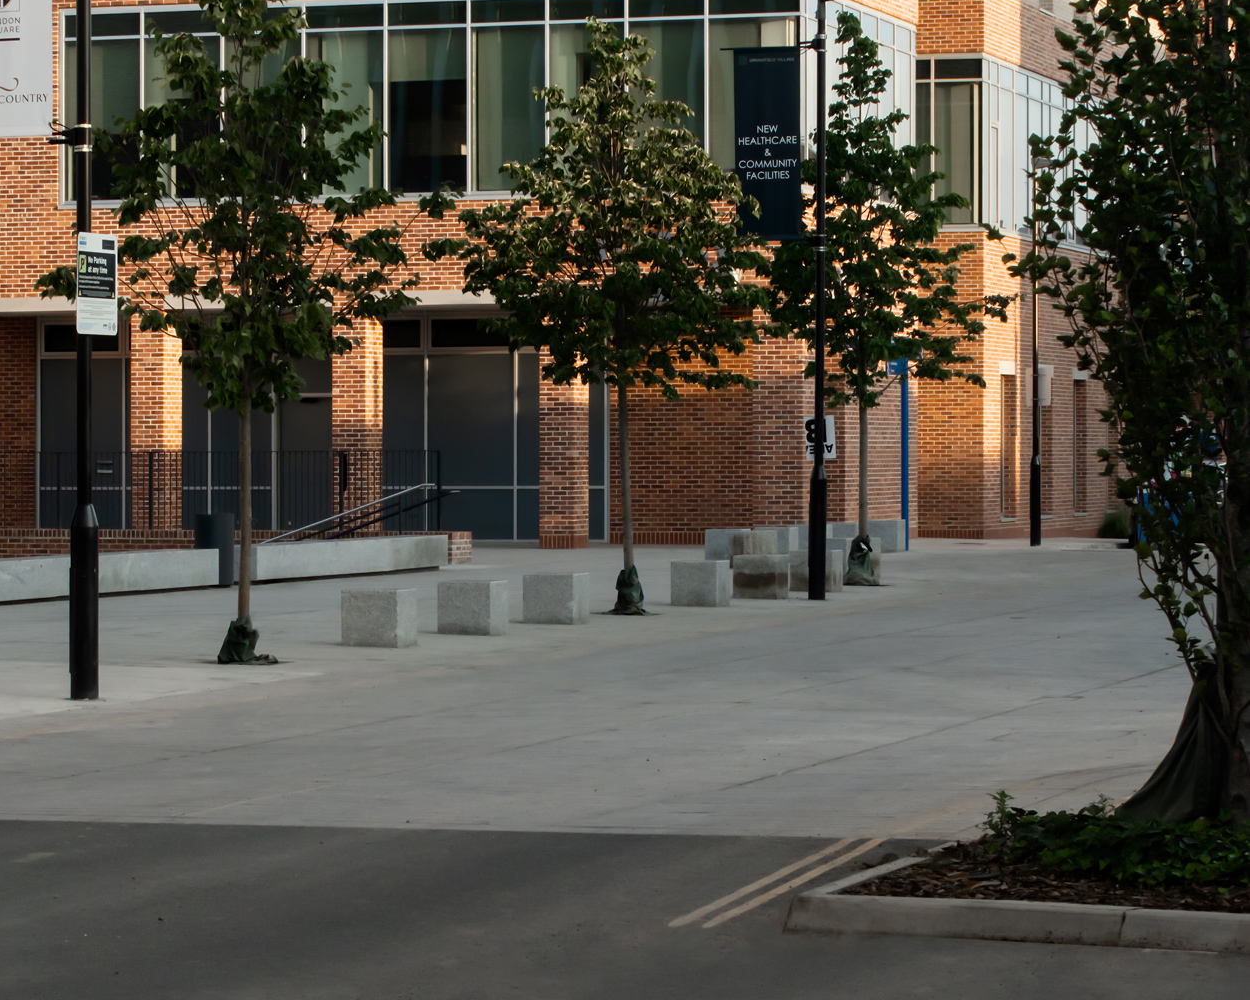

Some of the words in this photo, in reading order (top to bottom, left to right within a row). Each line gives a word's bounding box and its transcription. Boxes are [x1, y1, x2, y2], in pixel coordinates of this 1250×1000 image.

[756, 124, 779, 134] NEW
[738, 135, 798, 146] HEALTHCARE
[764, 148, 772, 157] &
[738, 158, 798, 169] COMMUNITY
[746, 170, 791, 180] FACILITIES
[94, 256, 107, 267] Parking
[100, 266, 108, 274] time
